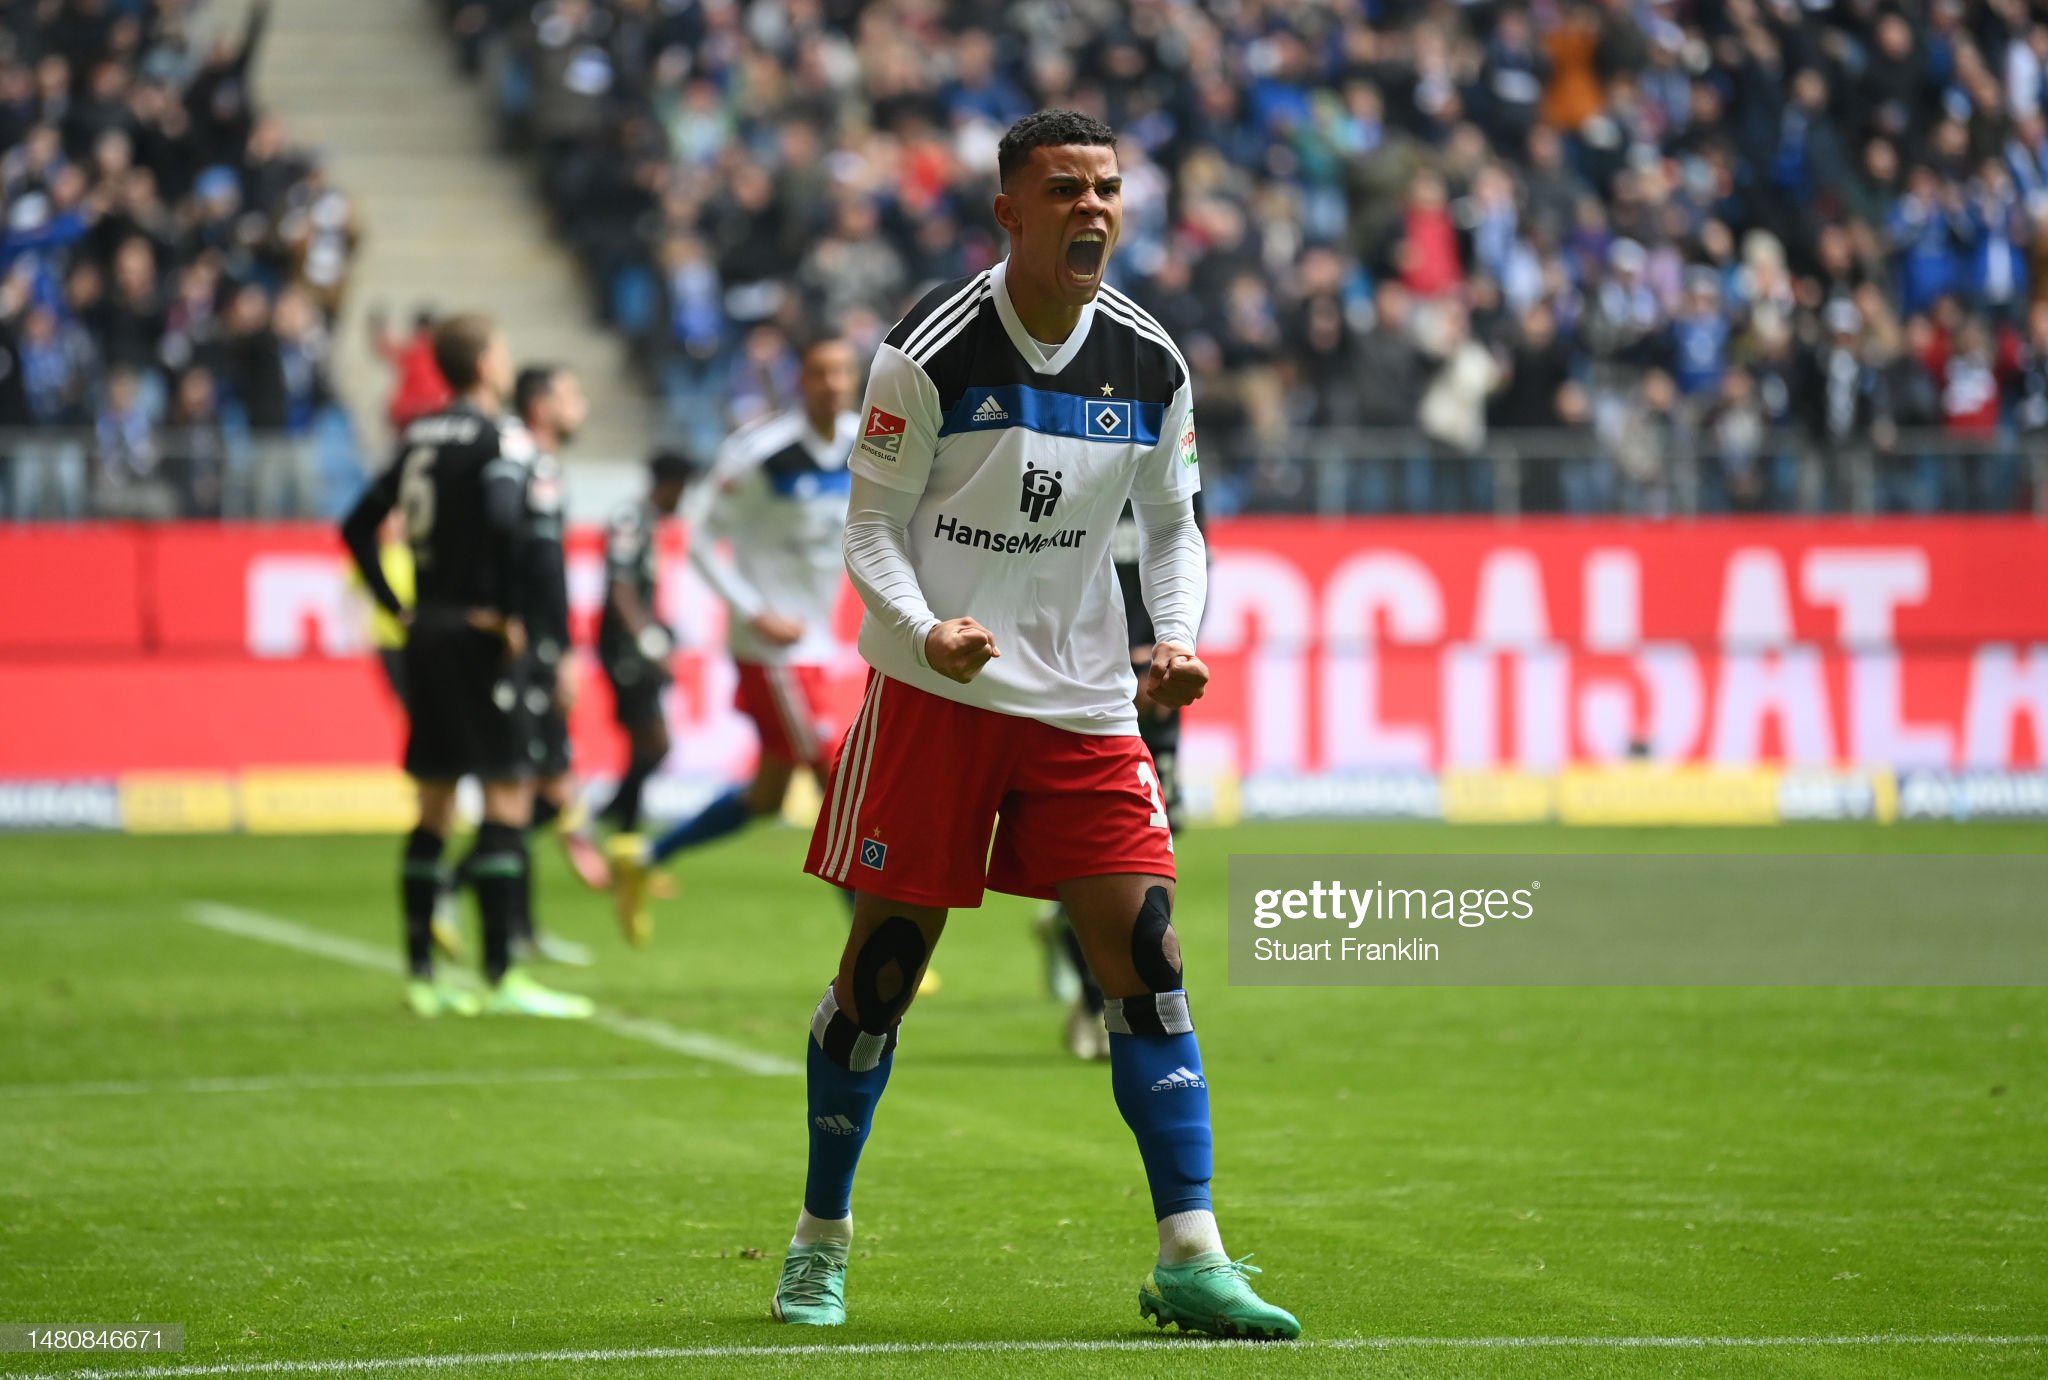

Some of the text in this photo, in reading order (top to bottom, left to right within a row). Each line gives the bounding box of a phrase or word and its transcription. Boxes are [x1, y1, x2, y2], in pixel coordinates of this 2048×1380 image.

[972, 411, 1009, 422] adidas
[860, 443, 897, 463] BUNDESLIGA
[934, 514, 1086, 554] HanseMekur
